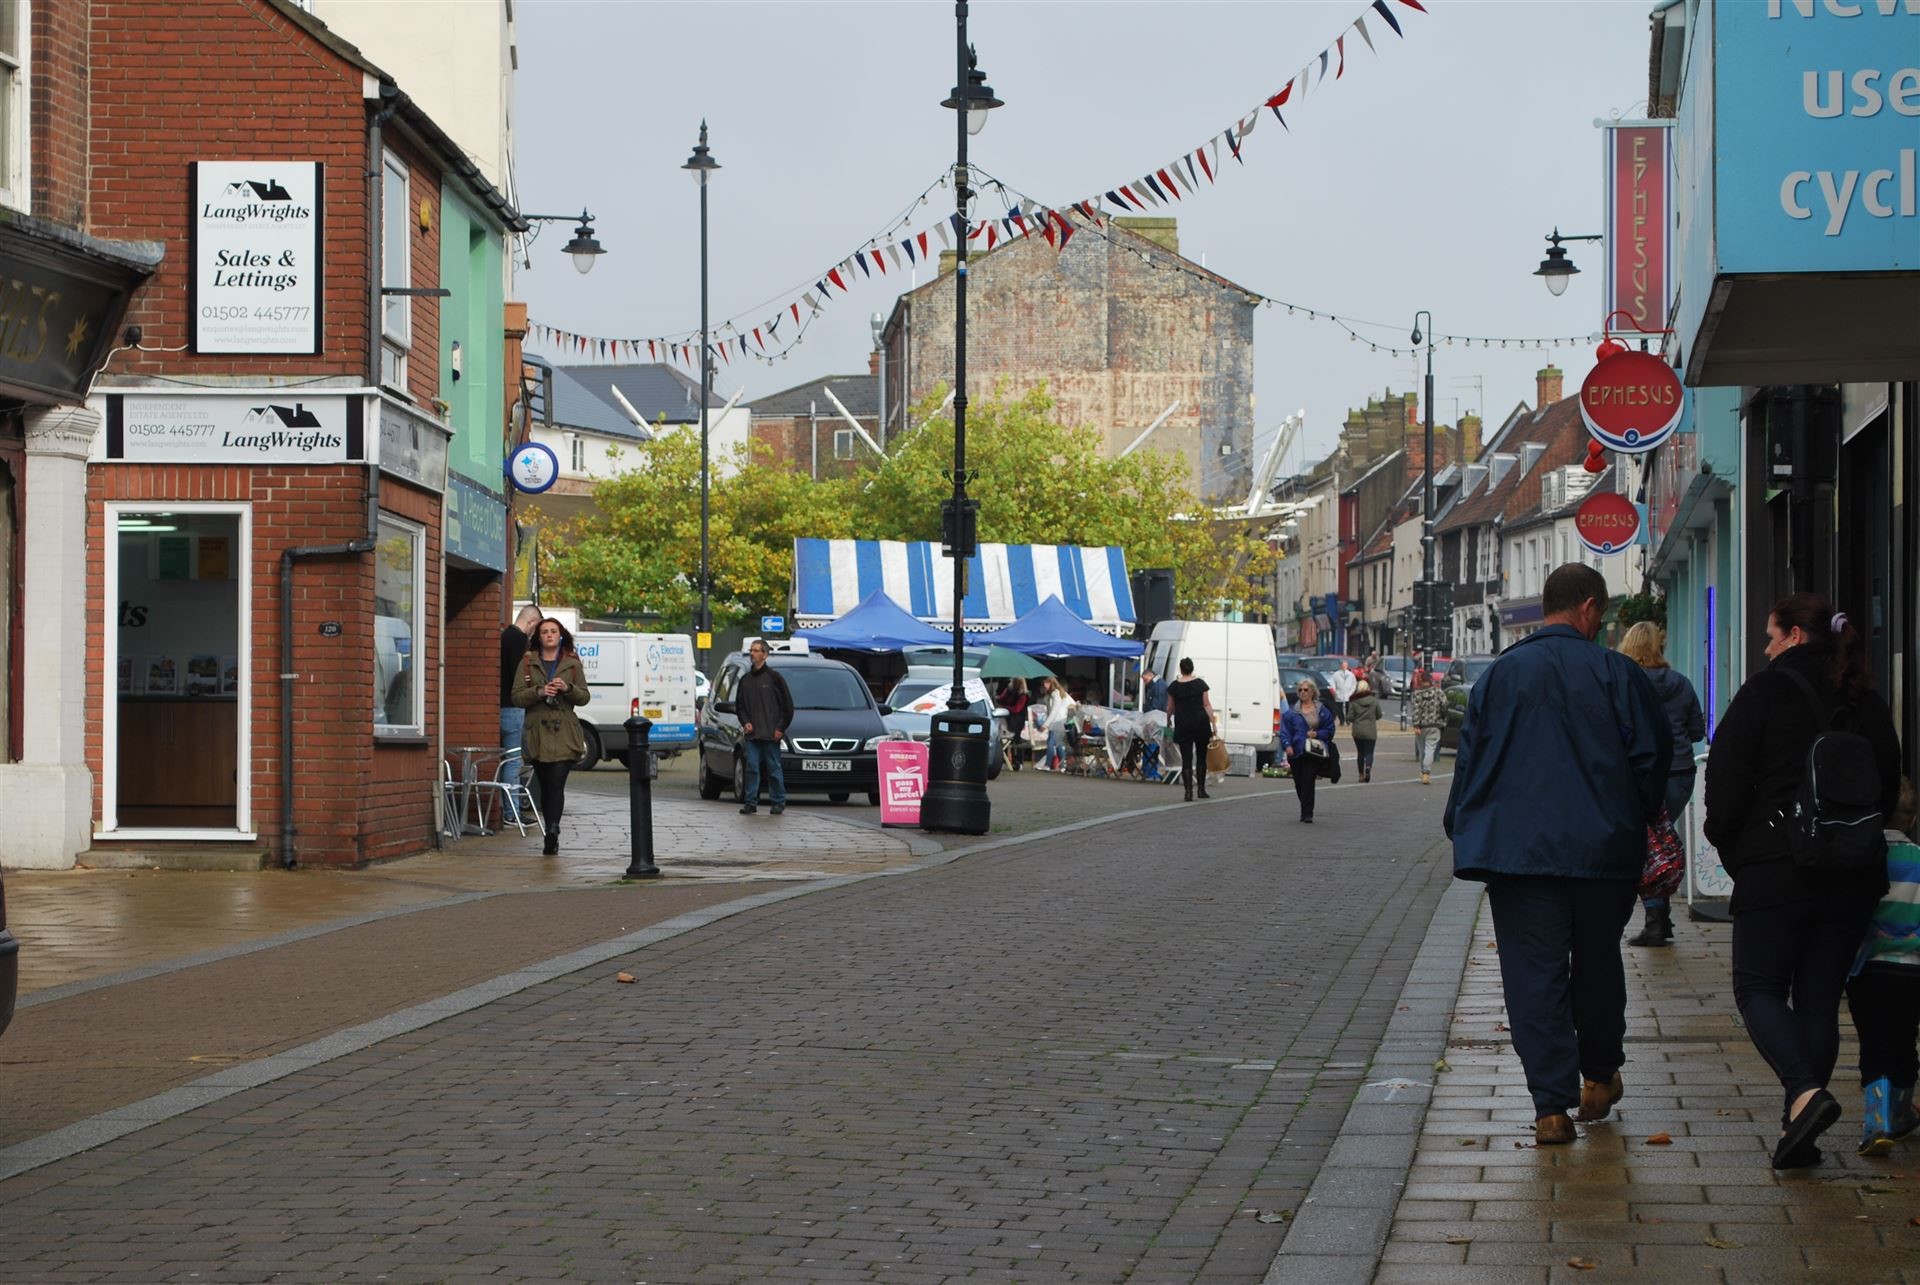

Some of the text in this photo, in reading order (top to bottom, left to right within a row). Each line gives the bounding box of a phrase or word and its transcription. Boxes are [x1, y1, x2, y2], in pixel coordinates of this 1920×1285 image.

[203, 203, 310, 223] LangWrights
[1633, 136, 1648, 321] EPHESUS
[215, 249, 296, 267] Sales &
[213, 270, 298, 292] Lettings
[201, 306, 310, 320] 01502 445777
[1588, 385, 1675, 406] EPHESUS
[129, 424, 215, 437] 01502 445777
[222, 431, 341, 452] LangWrights
[1579, 512, 1635, 528] EPHESUS
[806, 760, 848, 770] KN55 TZK
[895, 780, 913, 788] pass
[894, 790, 919, 800] parcel
